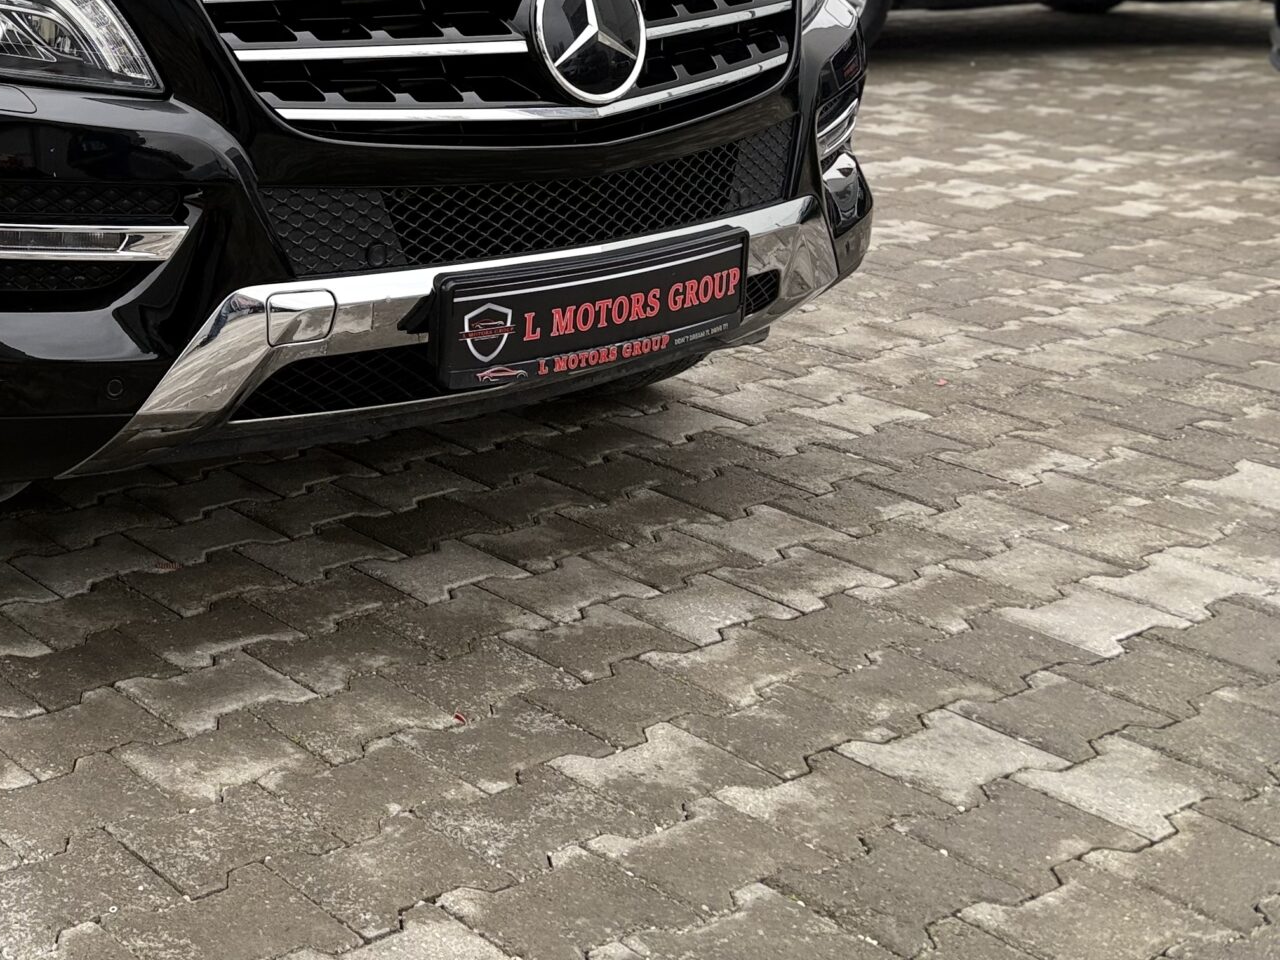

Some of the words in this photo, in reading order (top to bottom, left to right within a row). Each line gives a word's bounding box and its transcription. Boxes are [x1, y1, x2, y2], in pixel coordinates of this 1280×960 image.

[523, 311, 540, 341] L
[550, 288, 661, 337] MOTORS
[667, 267, 741, 312] GROUP
[537, 358, 549, 376] L
[553, 346, 618, 373] MOTORS
[621, 334, 670, 359] GROUP
